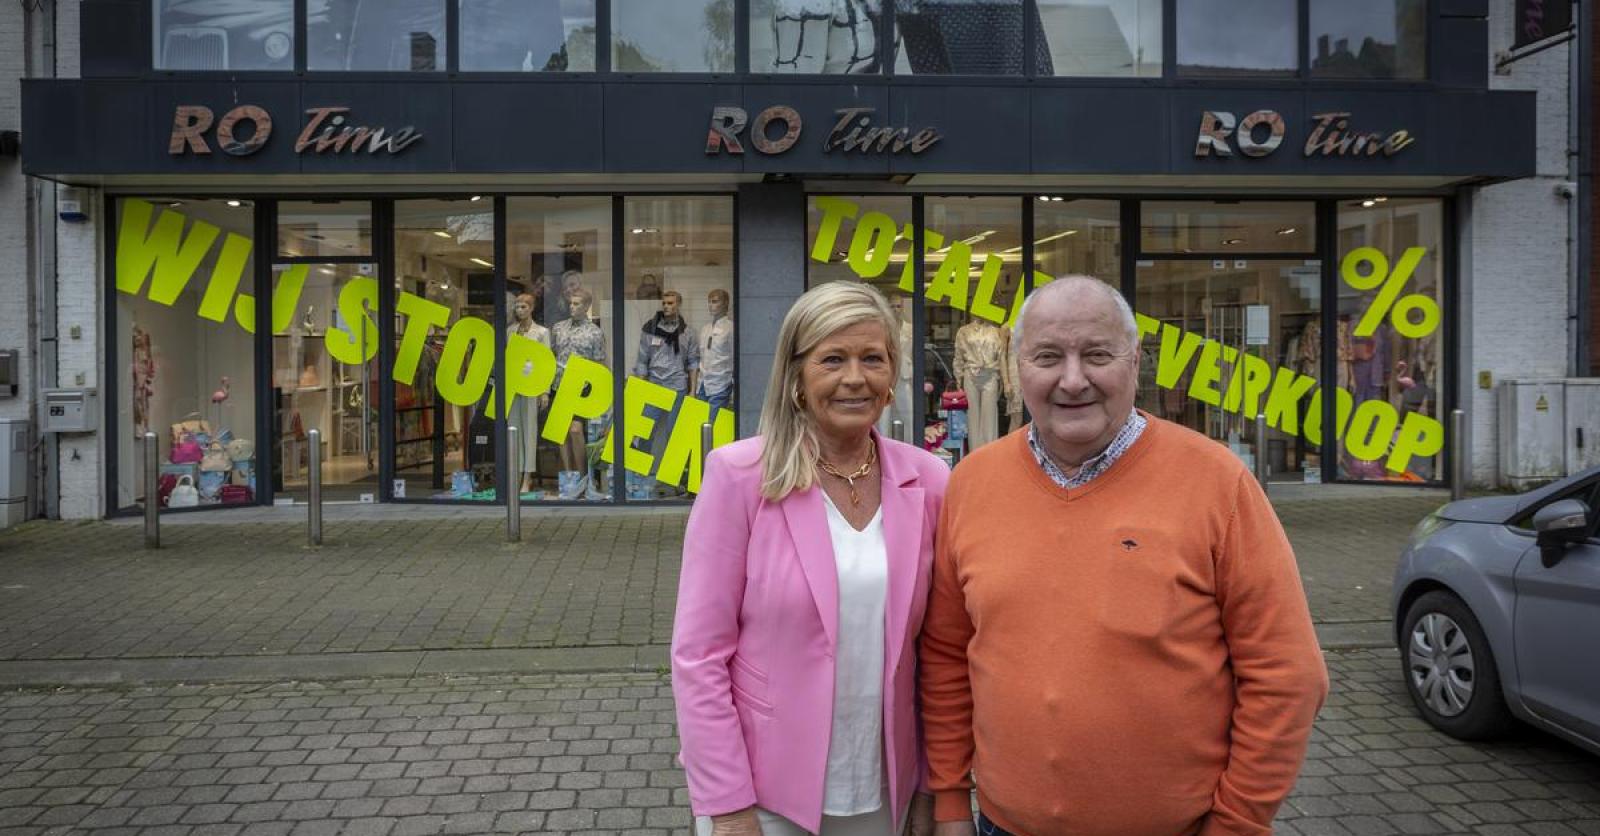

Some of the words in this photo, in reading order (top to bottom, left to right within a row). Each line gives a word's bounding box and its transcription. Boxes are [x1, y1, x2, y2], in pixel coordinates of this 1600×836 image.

[168, 105, 273, 156] RO
[294, 107, 422, 154] Time
[705, 105, 802, 155] RO
[823, 107, 943, 154] Time
[1195, 110, 1286, 157] RO
[1304, 112, 1414, 157] Time
[1341, 247, 1441, 338] %
[115, 198, 310, 334] WIJ
[324, 276, 736, 495] STOPPEN
